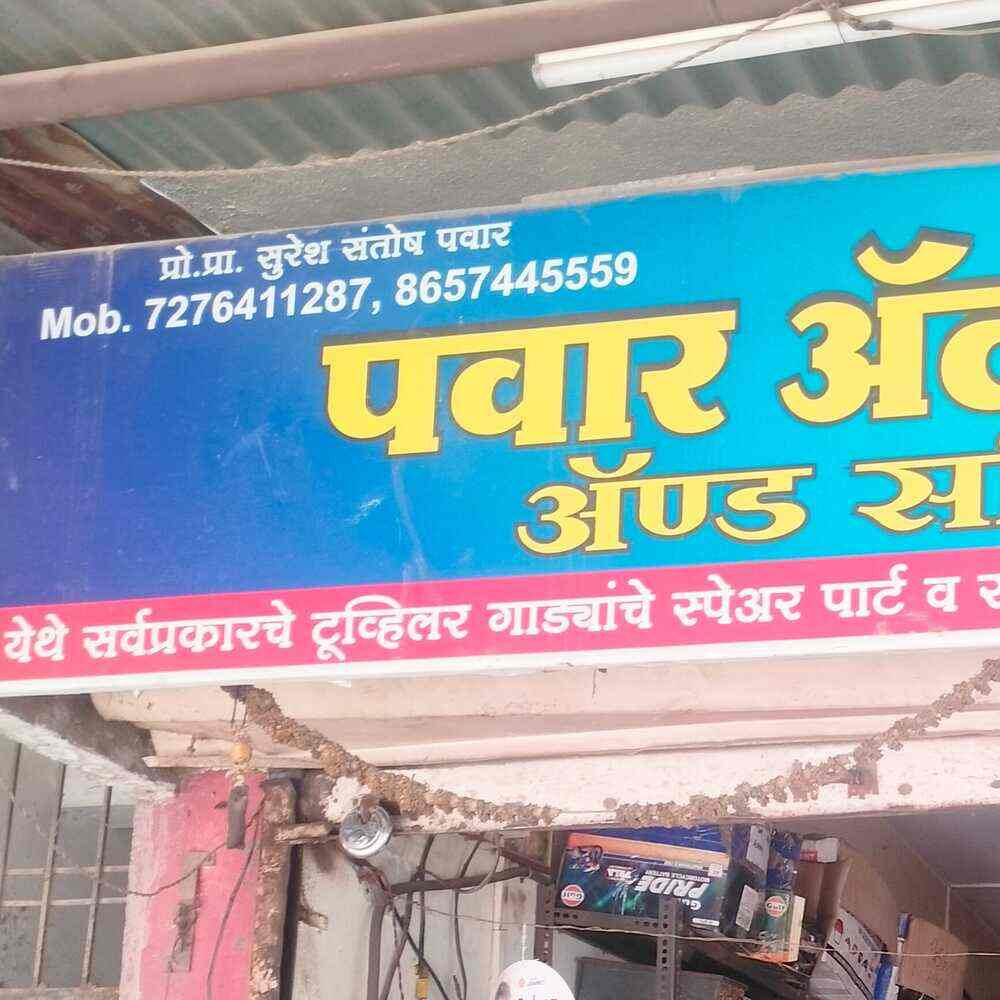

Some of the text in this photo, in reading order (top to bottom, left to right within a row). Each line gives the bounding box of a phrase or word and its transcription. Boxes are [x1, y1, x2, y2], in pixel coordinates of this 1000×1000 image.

[40, 251, 638, 340] Mob. 7276411287, 8657445559
[256, 233, 332, 281] सुरेश
[341, 224, 426, 262] संतोष
[436, 221, 512, 252] पवार
[321, 307, 738, 456] पवार
[4, 613, 70, 663] येथे
[82, 599, 297, 659] सर्वप्रकारचे
[310, 594, 472, 662] टूव्हिलर
[486, 578, 656, 637] गाड्यांचे
[671, 573, 805, 627] स्पेअर
[820, 563, 909, 619] पार्ट
[922, 575, 961, 613] व
[635, 875, 711, 899] PRIDE
